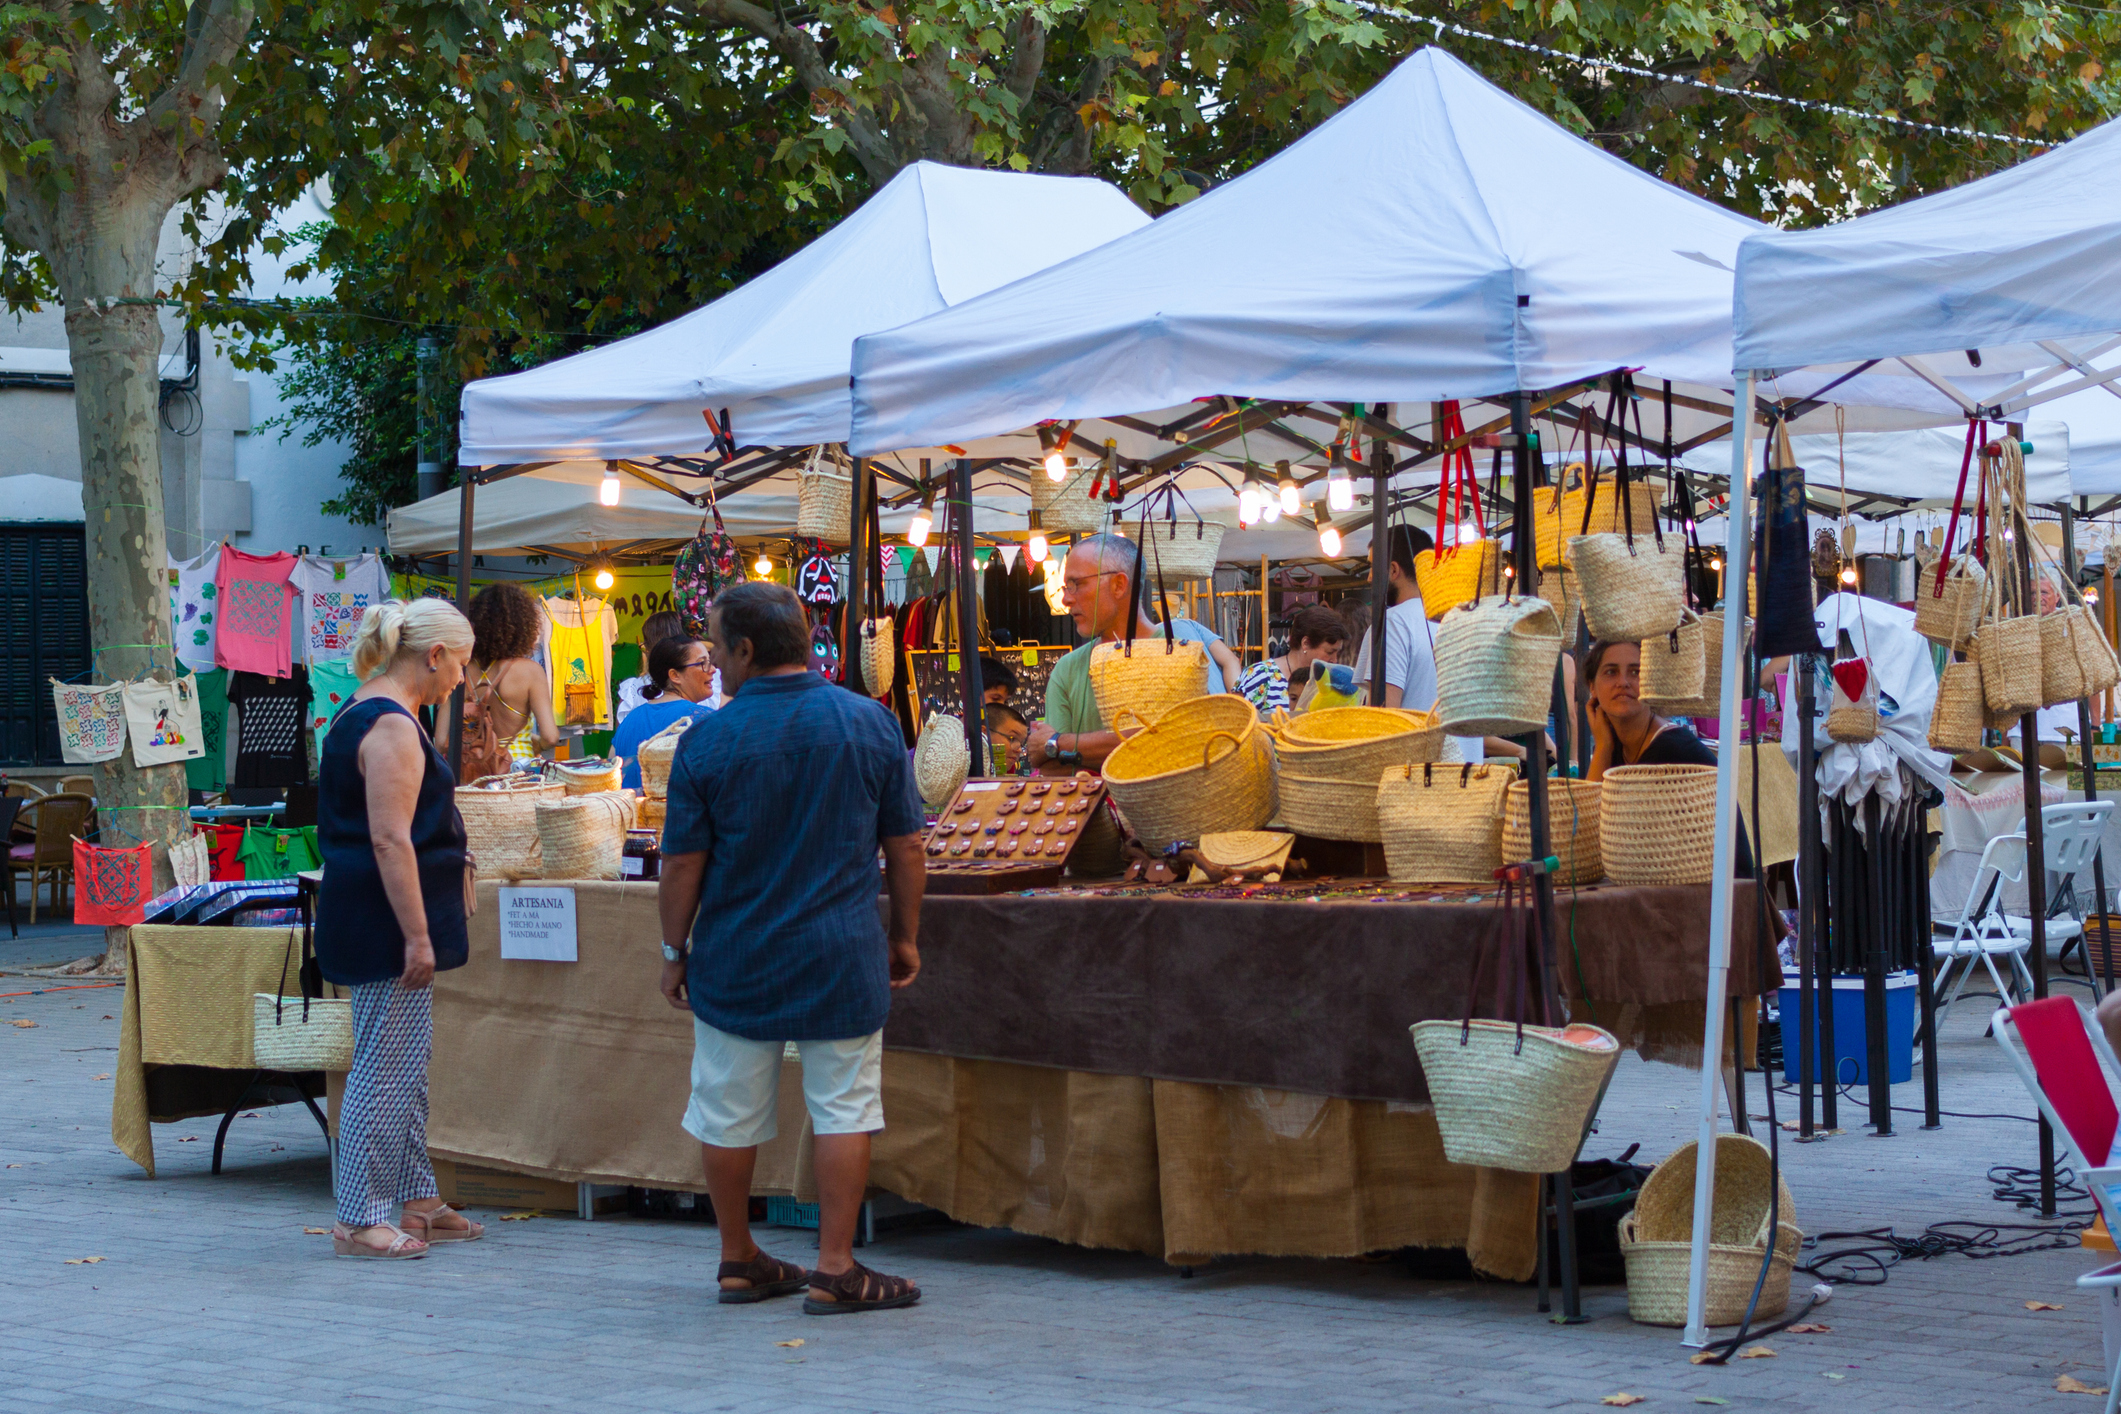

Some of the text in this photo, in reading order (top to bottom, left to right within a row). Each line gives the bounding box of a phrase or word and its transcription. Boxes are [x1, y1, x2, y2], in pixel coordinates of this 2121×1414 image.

[511, 897, 564, 909] ARTESANIA
[535, 921, 541, 929] A
[541, 921, 563, 930] MANO
